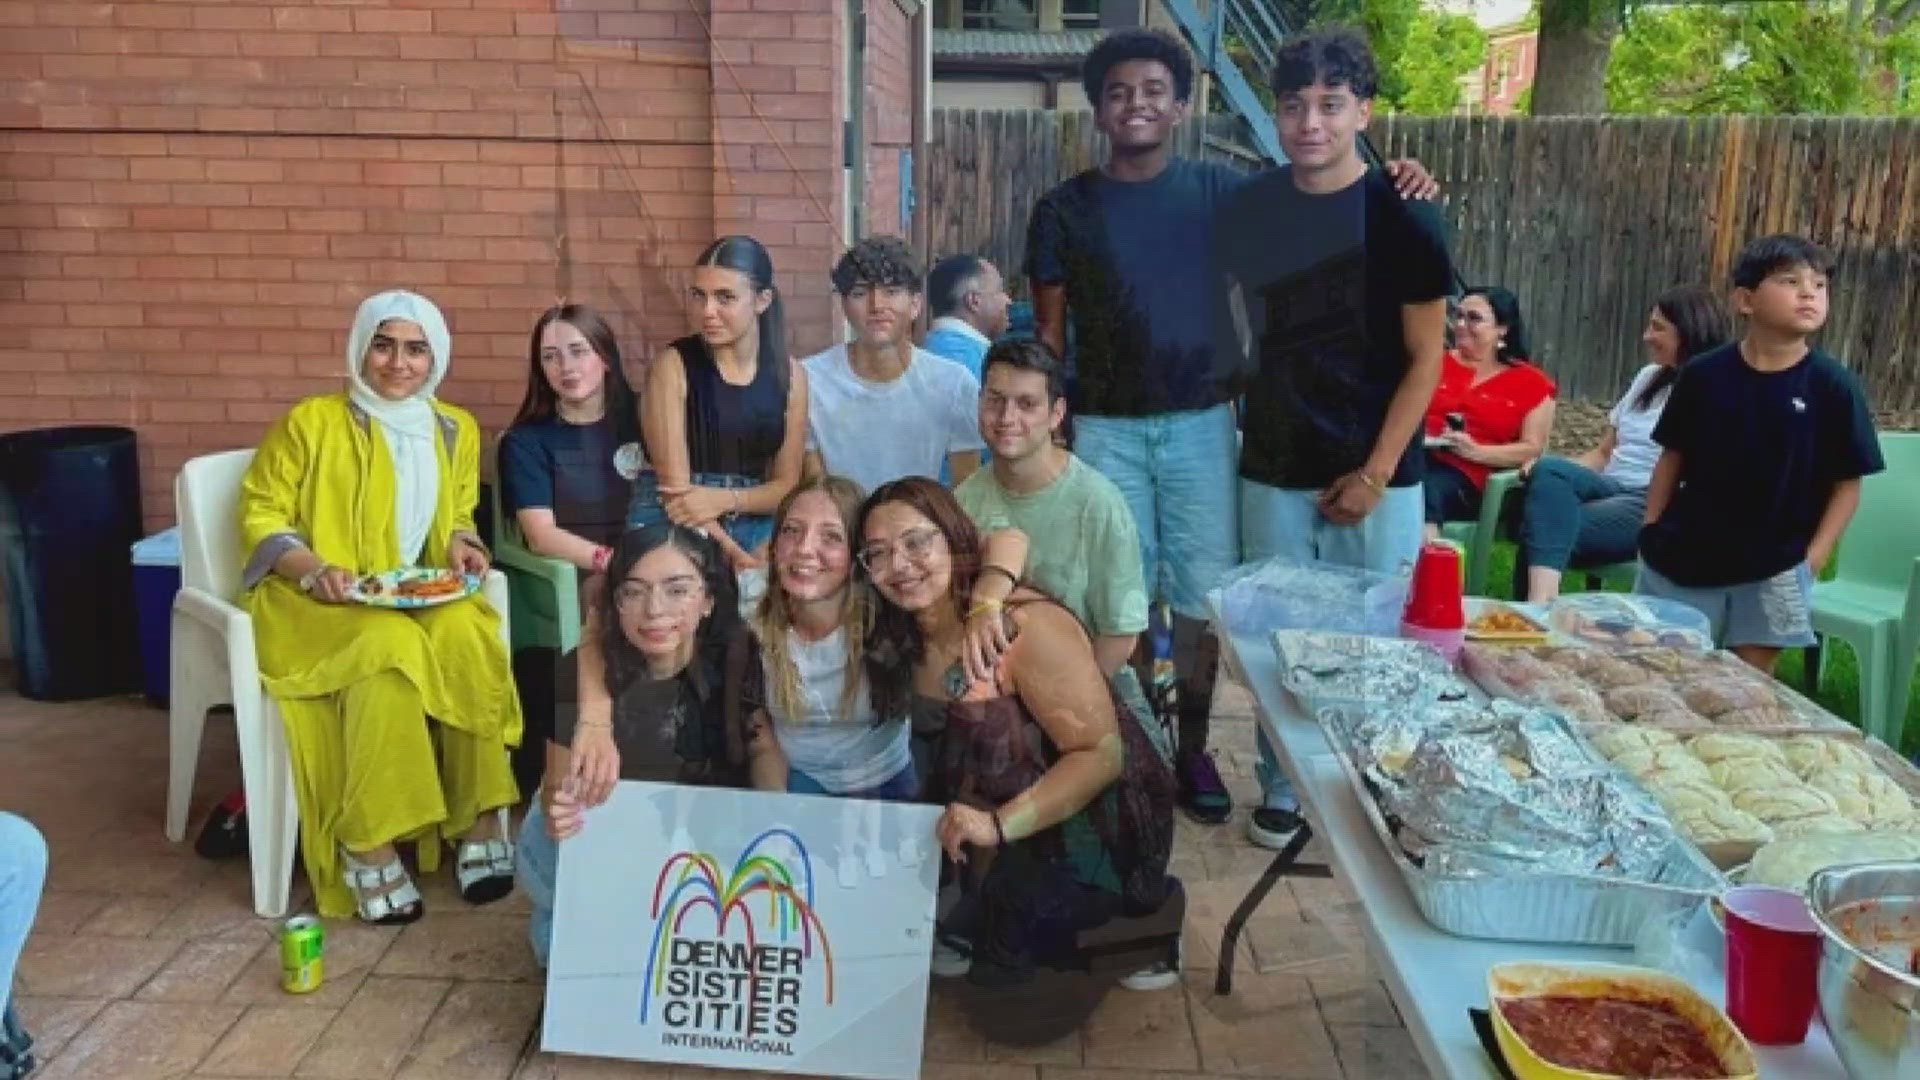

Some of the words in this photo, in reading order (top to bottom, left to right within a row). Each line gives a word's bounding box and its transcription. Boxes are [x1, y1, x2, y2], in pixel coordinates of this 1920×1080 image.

[671, 938, 802, 974] DENVER
[667, 968, 801, 1004] SISTER
[664, 1000, 797, 1036] CITIES
[662, 1034, 794, 1055] INTERNATIONAL
